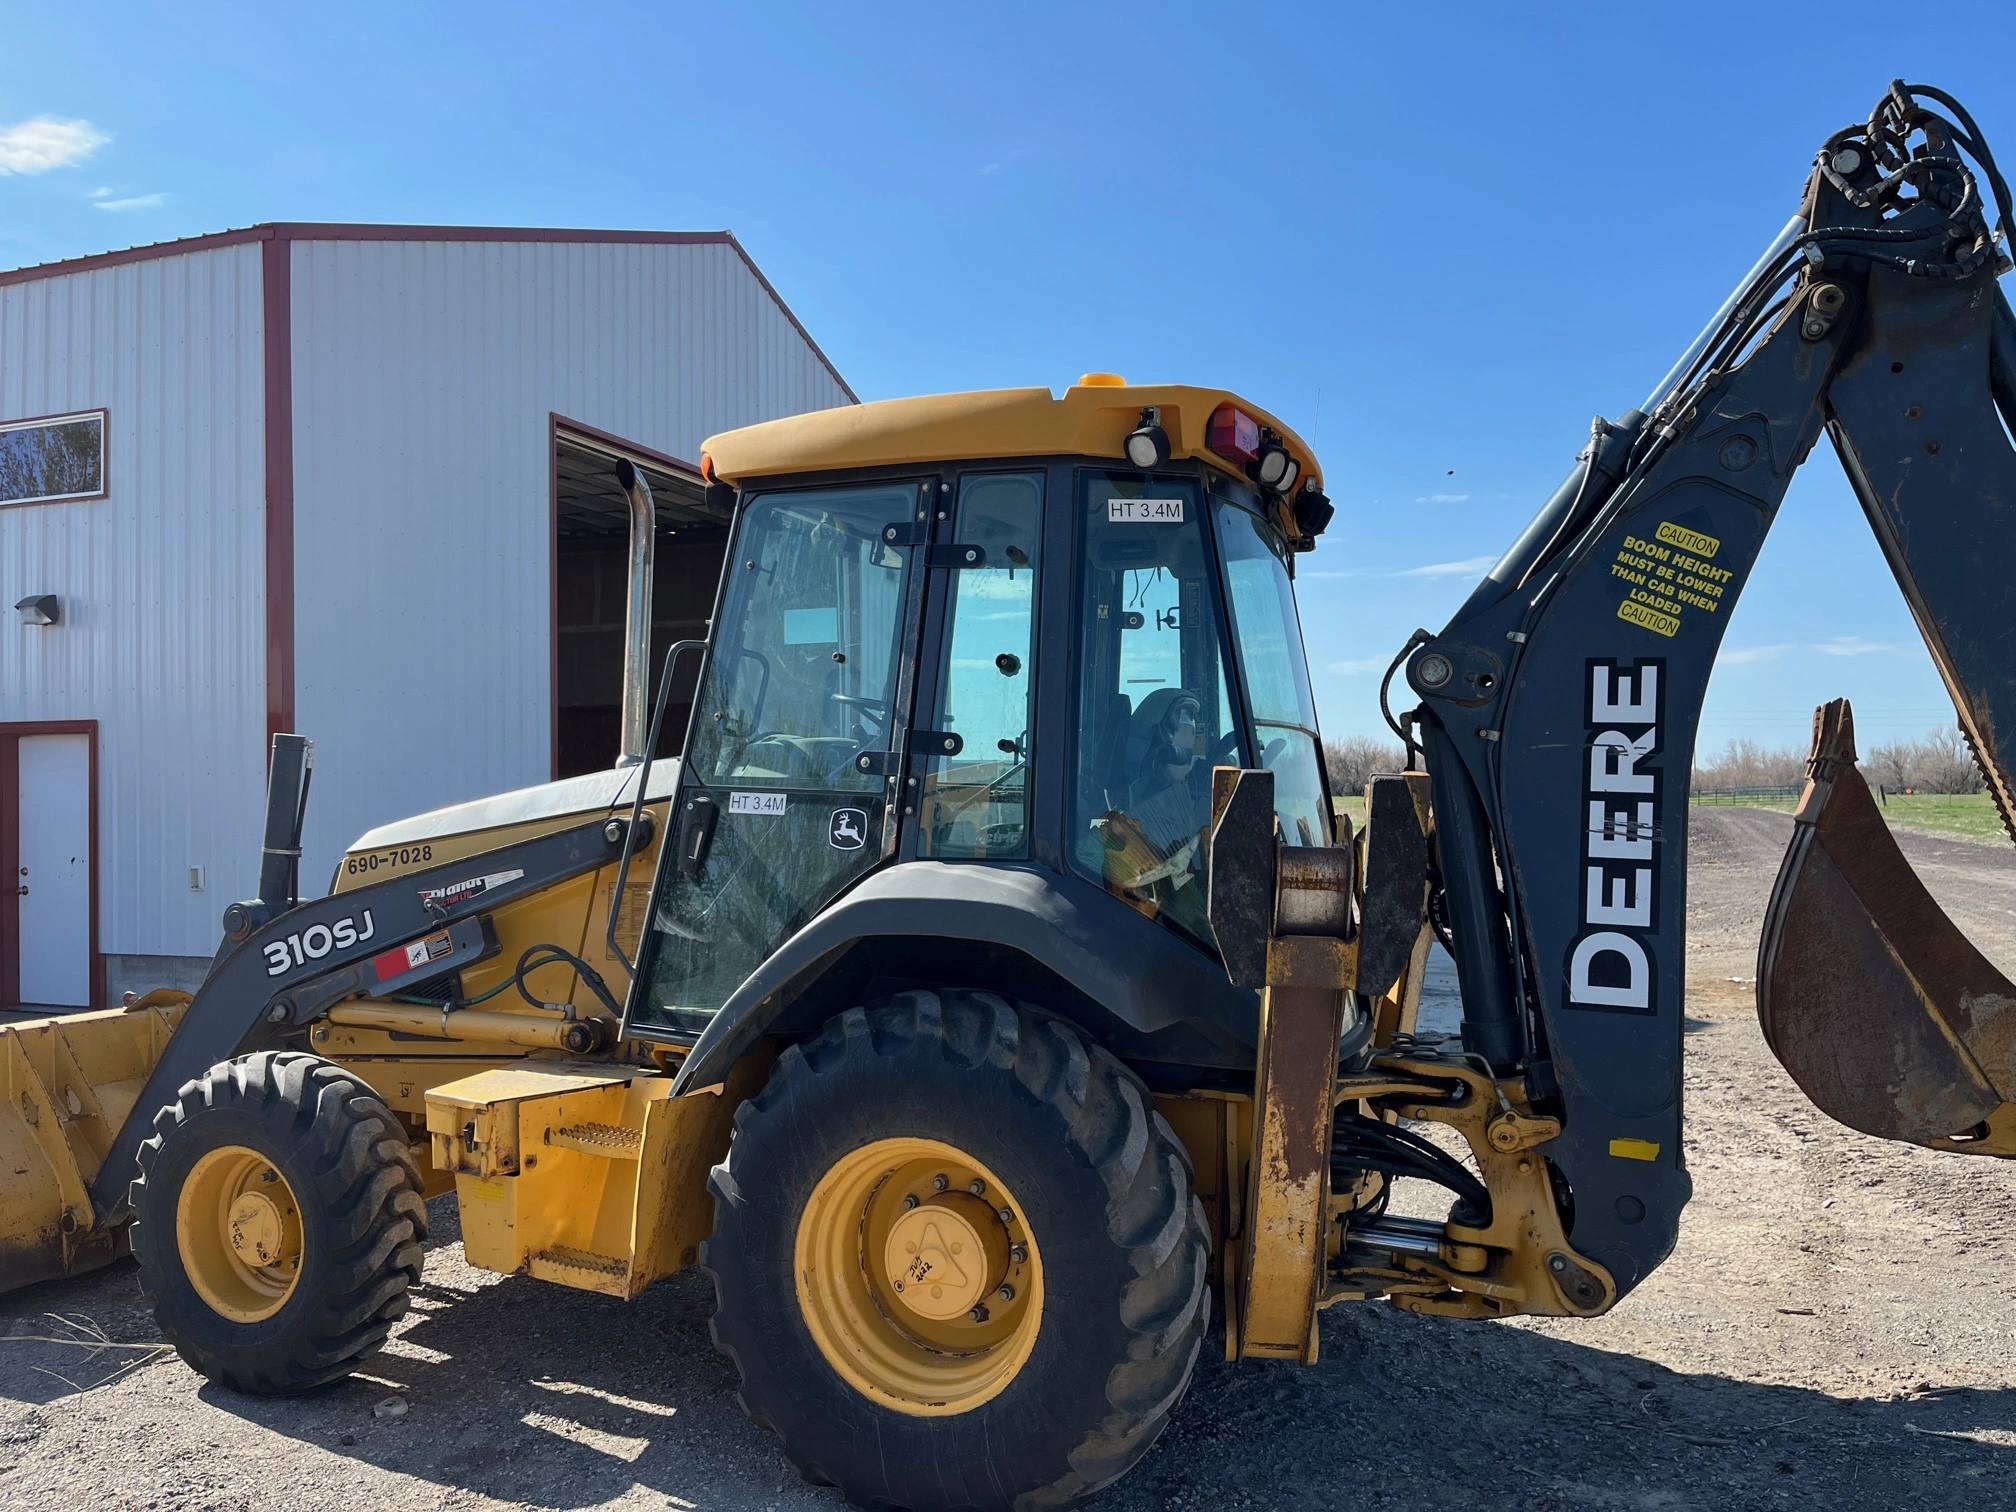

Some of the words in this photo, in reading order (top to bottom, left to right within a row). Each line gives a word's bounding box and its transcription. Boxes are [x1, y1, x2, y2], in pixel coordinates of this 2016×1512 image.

[1111, 503, 1135, 517] HT
[1140, 503, 1180, 518] 3.4M
[1659, 525, 1718, 555] CAUTION
[1623, 535, 1671, 562] BOOM
[1671, 553, 1733, 583] HEIGHT
[1611, 564, 1647, 586] THAN
[1647, 579, 1676, 596] CAB
[1677, 589, 1718, 612] WHEN
[1617, 551, 1656, 572] MUST
[1656, 565, 1676, 580] BE
[1676, 572, 1724, 598] LOWER
[1629, 588, 1682, 615] LOADED
[1621, 604, 1678, 634] CAUTION
[731, 796, 750, 809] HT
[753, 797, 785, 811] 3.4M
[1570, 665, 1658, 1008] DEERE
[348, 845, 432, 874] 690-7028
[263, 910, 375, 976] 310SJ
